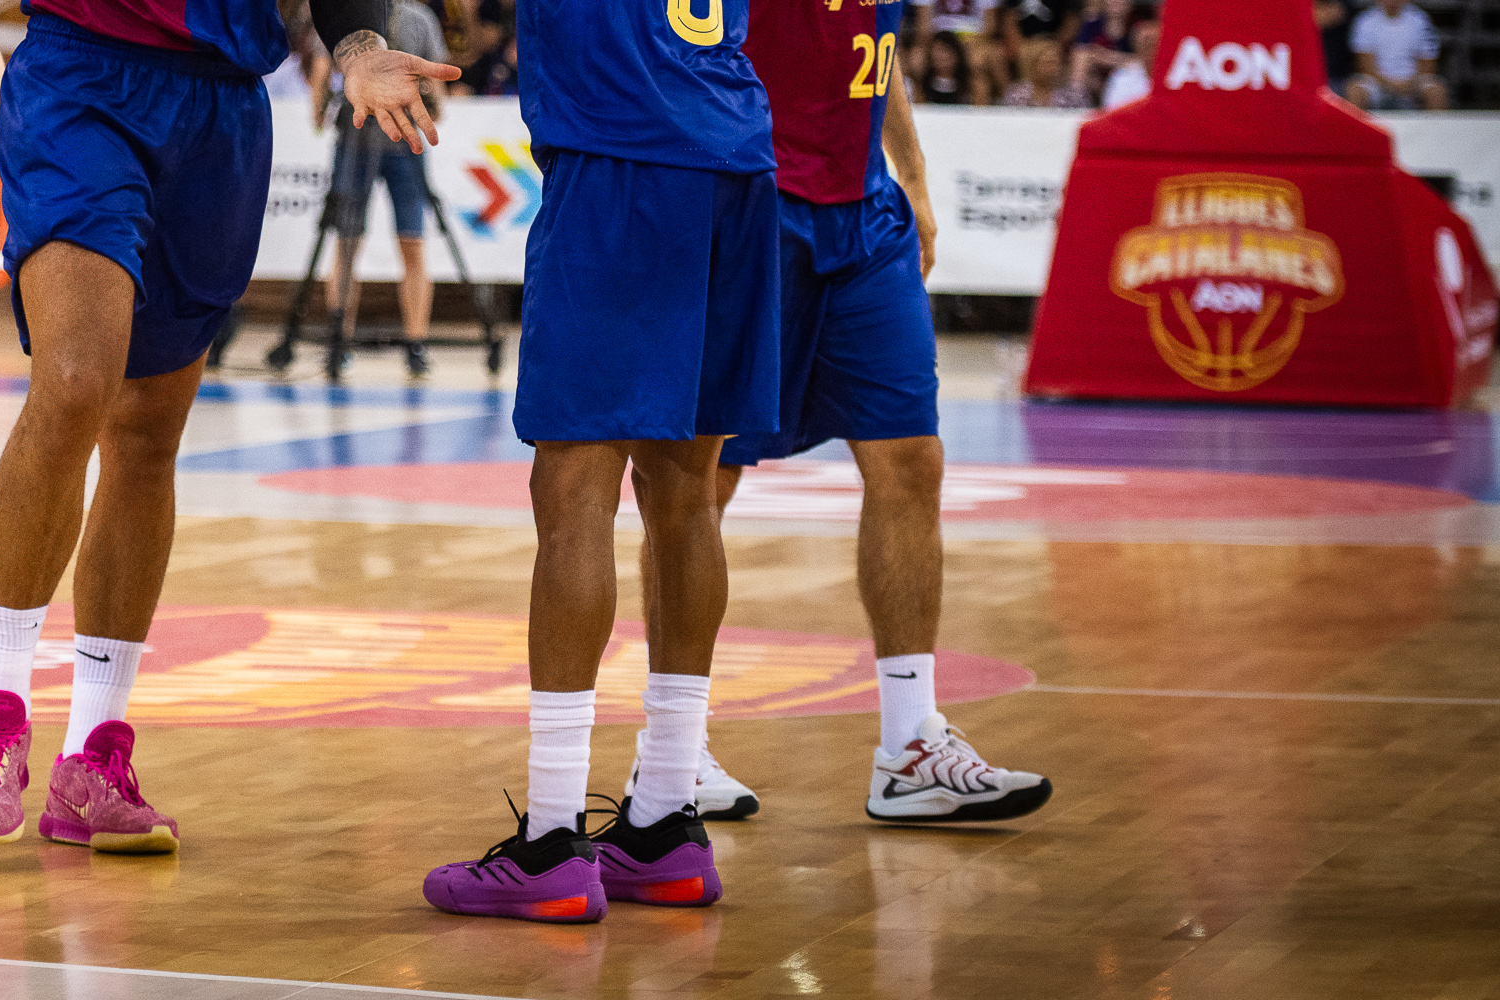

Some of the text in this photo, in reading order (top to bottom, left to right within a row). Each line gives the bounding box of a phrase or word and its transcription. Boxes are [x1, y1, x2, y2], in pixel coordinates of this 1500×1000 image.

[849, 32, 896, 99] 20
[1165, 36, 1291, 91] AON
[1191, 279, 1265, 314] AON
